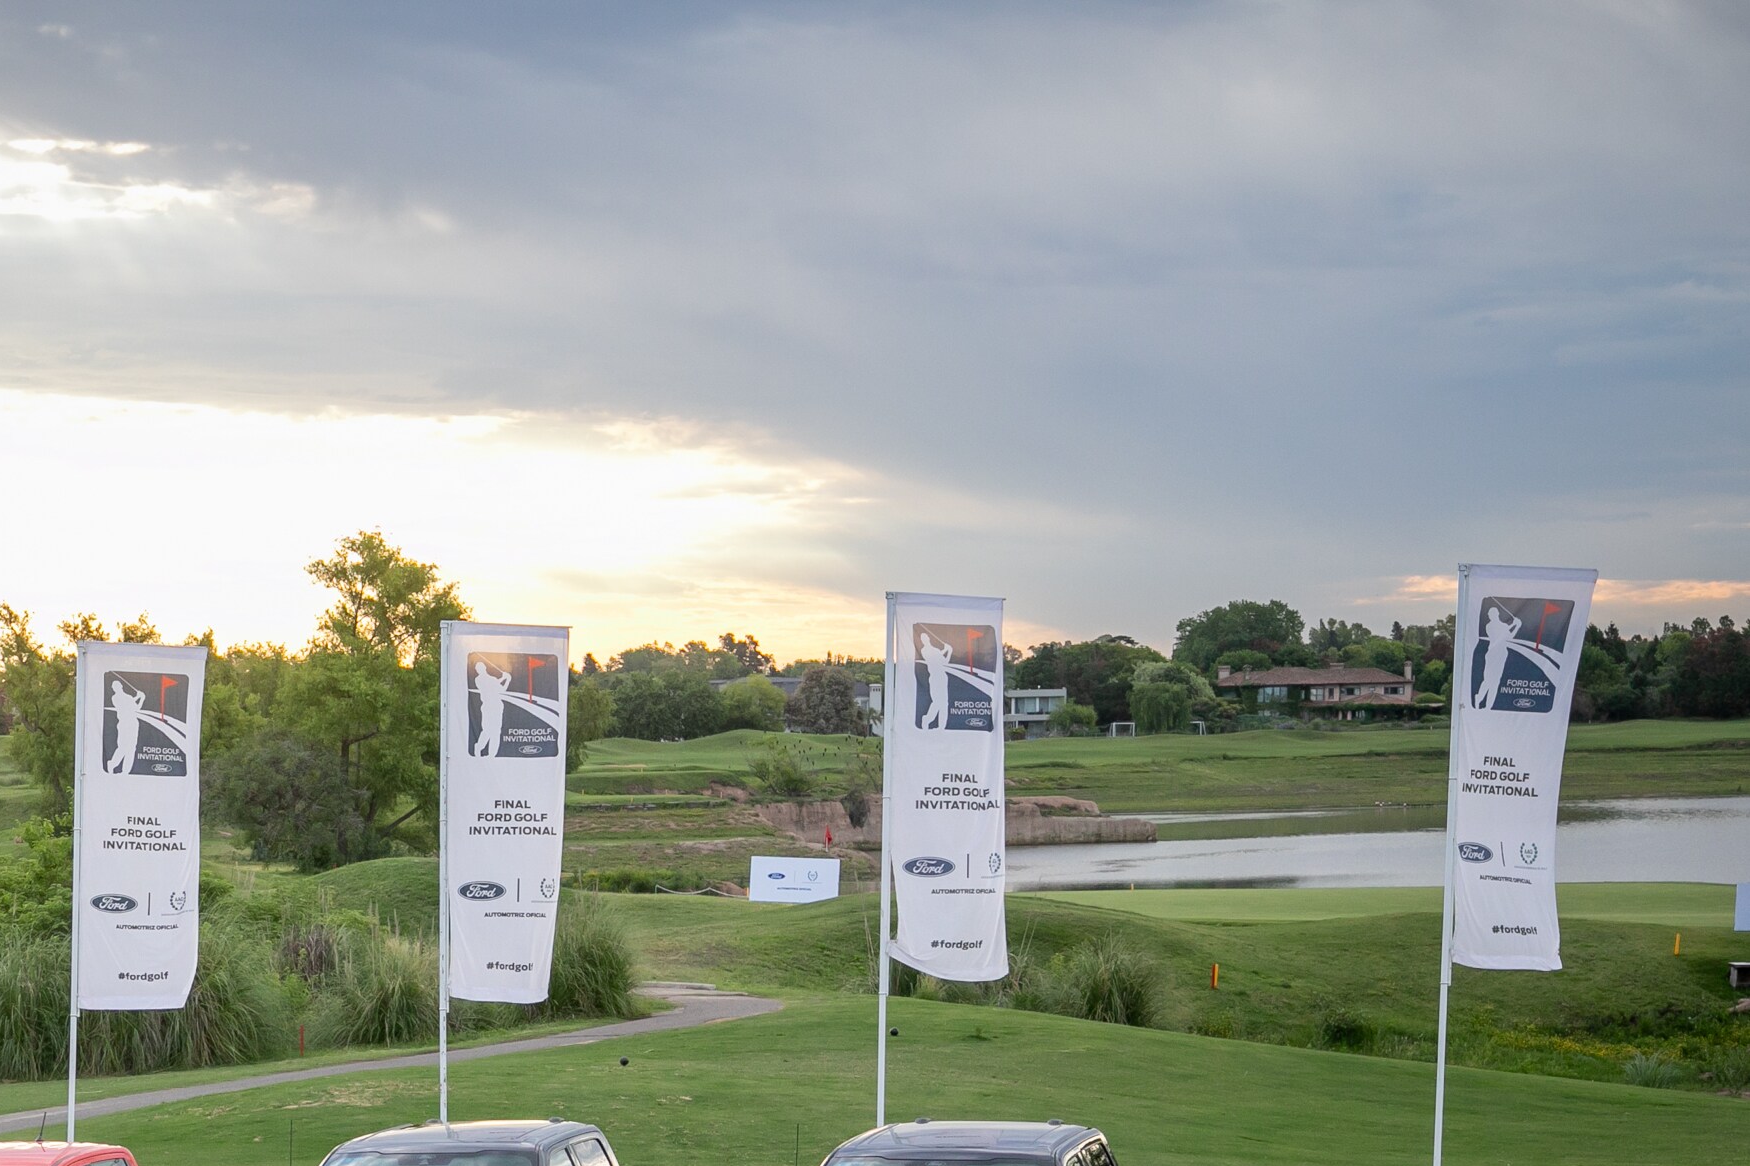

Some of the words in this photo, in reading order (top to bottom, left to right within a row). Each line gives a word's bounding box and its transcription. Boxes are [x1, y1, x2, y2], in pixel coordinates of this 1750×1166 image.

[1506, 679, 1528, 687] FORD
[1529, 680, 1550, 688] GOLF
[1500, 687, 1551, 696] INVITATIONAL
[954, 700, 974, 708] FORD
[950, 708, 992, 716] INVITATION
[143, 746, 162, 754] FORD
[162, 747, 180, 755] GOLF
[137, 753, 184, 762] INVITATIONAL
[1483, 756, 1516, 767] FINAL
[942, 773, 978, 783] FINAL
[1470, 769, 1497, 781] FORD
[1499, 772, 1530, 783] GOLF
[924, 787, 960, 796] FORD
[963, 787, 990, 798] GOLF
[1462, 782, 1538, 797] INVITATIONAL
[494, 800, 531, 809] FINAL
[915, 799, 1000, 811] INVITATIONAL
[127, 816, 161, 826] FINAL
[477, 813, 512, 822] FORD
[514, 813, 548, 822] GOLF
[111, 828, 143, 838] FORD
[145, 830, 177, 839] GOLF
[469, 826, 557, 836] INVITATIONAL
[103, 841, 187, 852] INVITATIONAL
[1460, 844, 1487, 861] Ford
[911, 859, 947, 875] Ford
[465, 883, 498, 899] Ford
[98, 896, 130, 911] Ford
[1492, 924, 1538, 936] #fordgolf
[931, 940, 983, 951] #fordgolf
[118, 971, 169, 982] #fordgolf
